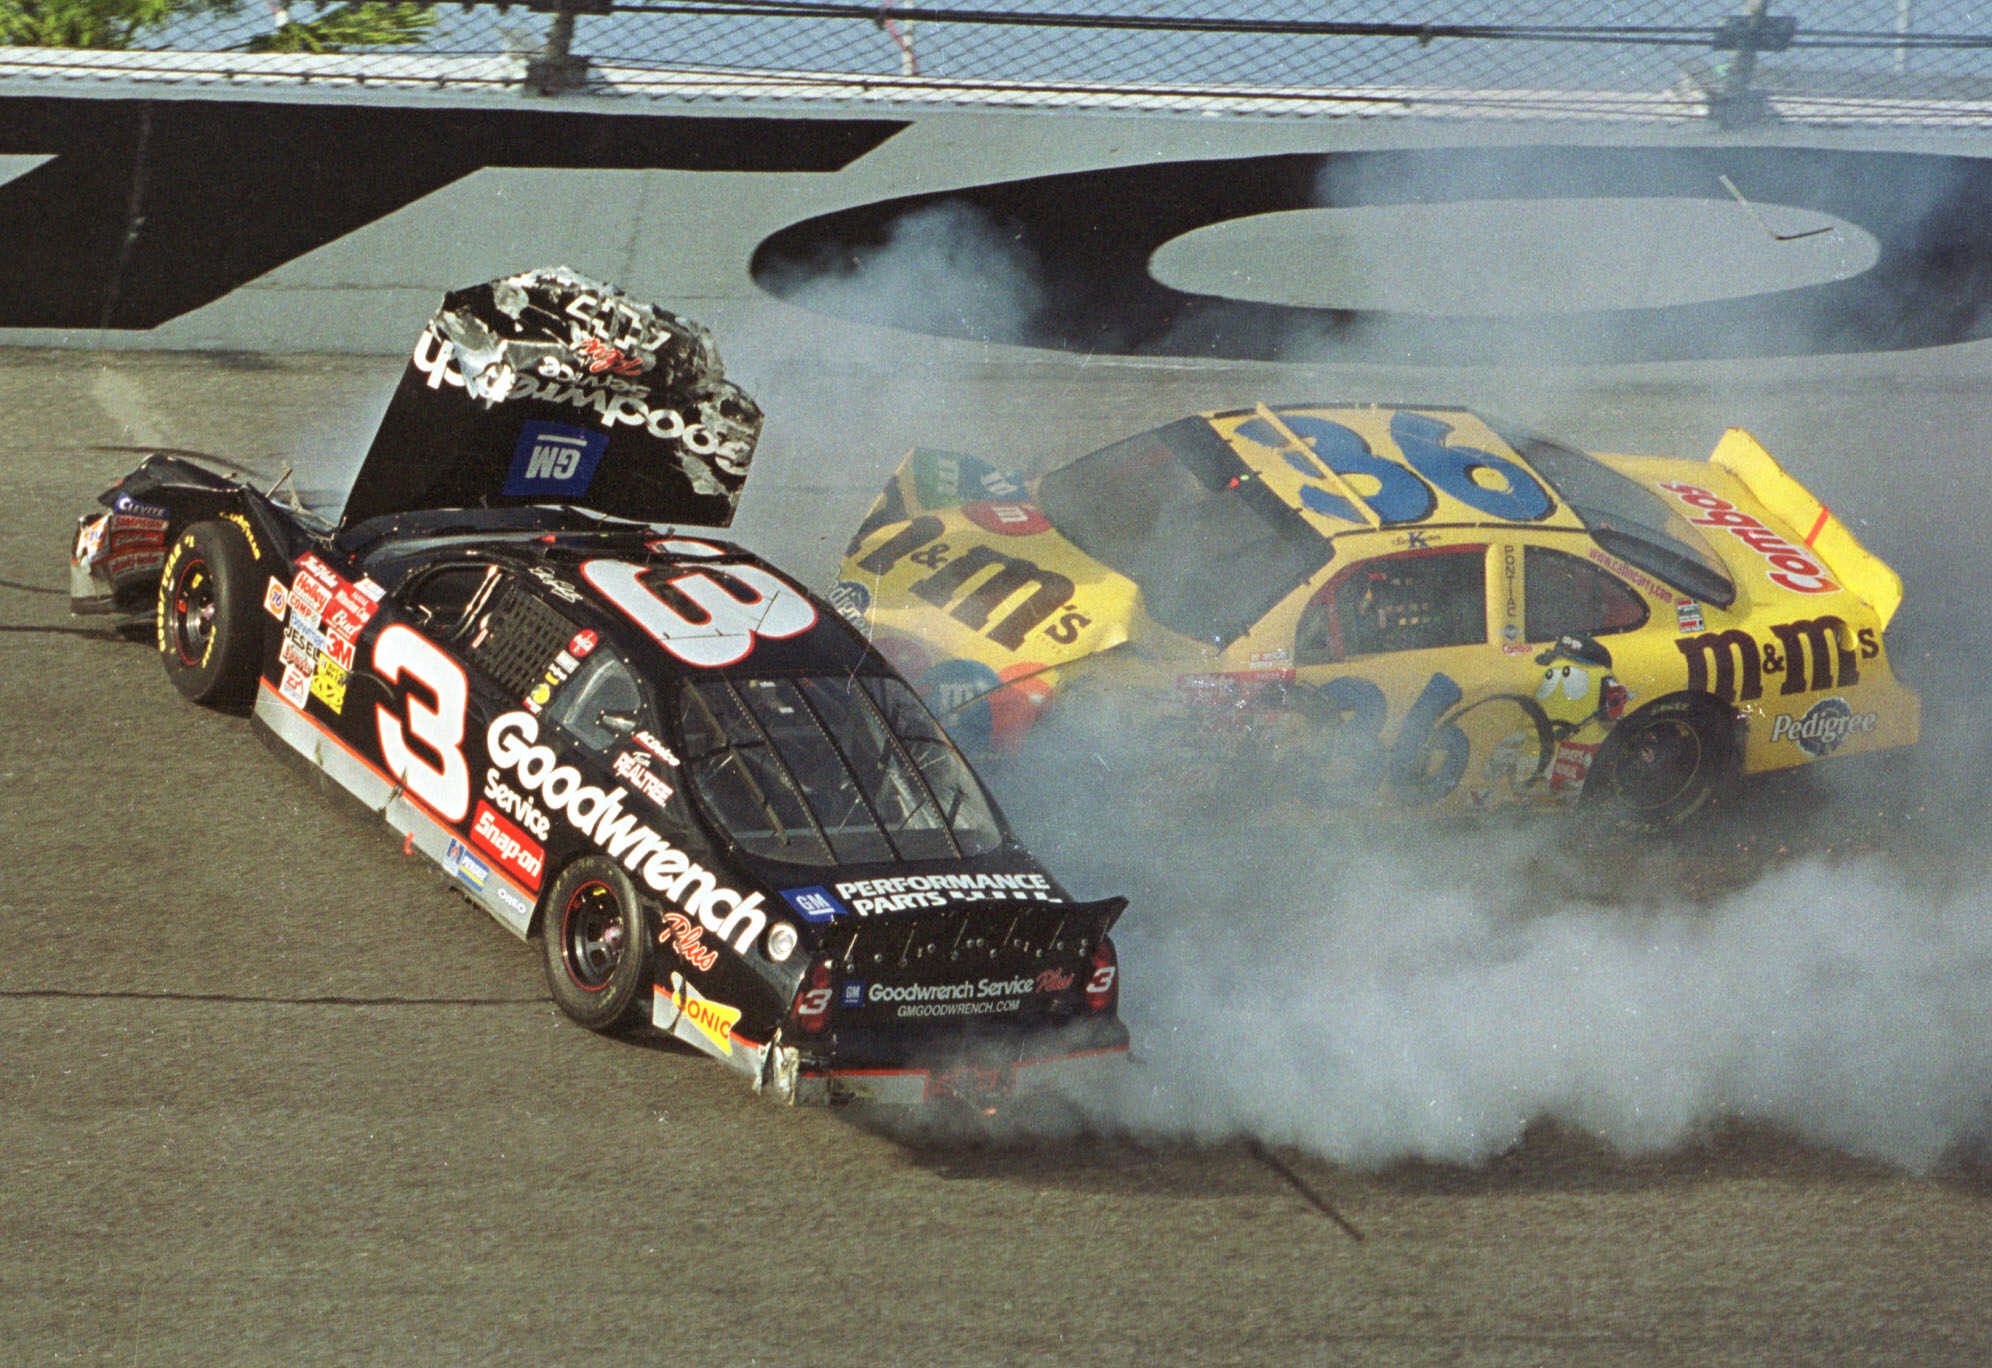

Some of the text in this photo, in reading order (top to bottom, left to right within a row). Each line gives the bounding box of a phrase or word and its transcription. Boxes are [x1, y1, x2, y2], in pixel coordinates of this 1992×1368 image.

[524, 445, 582, 480] GM
[1657, 479, 1845, 595] Combos
[296, 573, 327, 612] Holley
[1504, 544, 1517, 618] PONTIAC
[331, 609, 363, 635] Bud
[579, 538, 819, 669] 3
[326, 632, 354, 672] 3M
[371, 623, 469, 824] 3
[1770, 705, 1877, 743] Pedigree
[484, 768, 550, 842] Service
[474, 810, 543, 878] Snap-on
[487, 711, 767, 955] Goodwrench
[796, 893, 830, 912] GM
[851, 891, 948, 917] PARTS
[835, 873, 1051, 900] PERFORMANCE
[658, 911, 719, 972] Plus
[844, 968, 1074, 1003] GM Goodwrench Service Plus
[1086, 967, 1116, 994] 3
[680, 998, 731, 1038] ONIC
[797, 988, 834, 1016] 3
[896, 999, 1022, 1019] GMGOODWRENCH.COM
